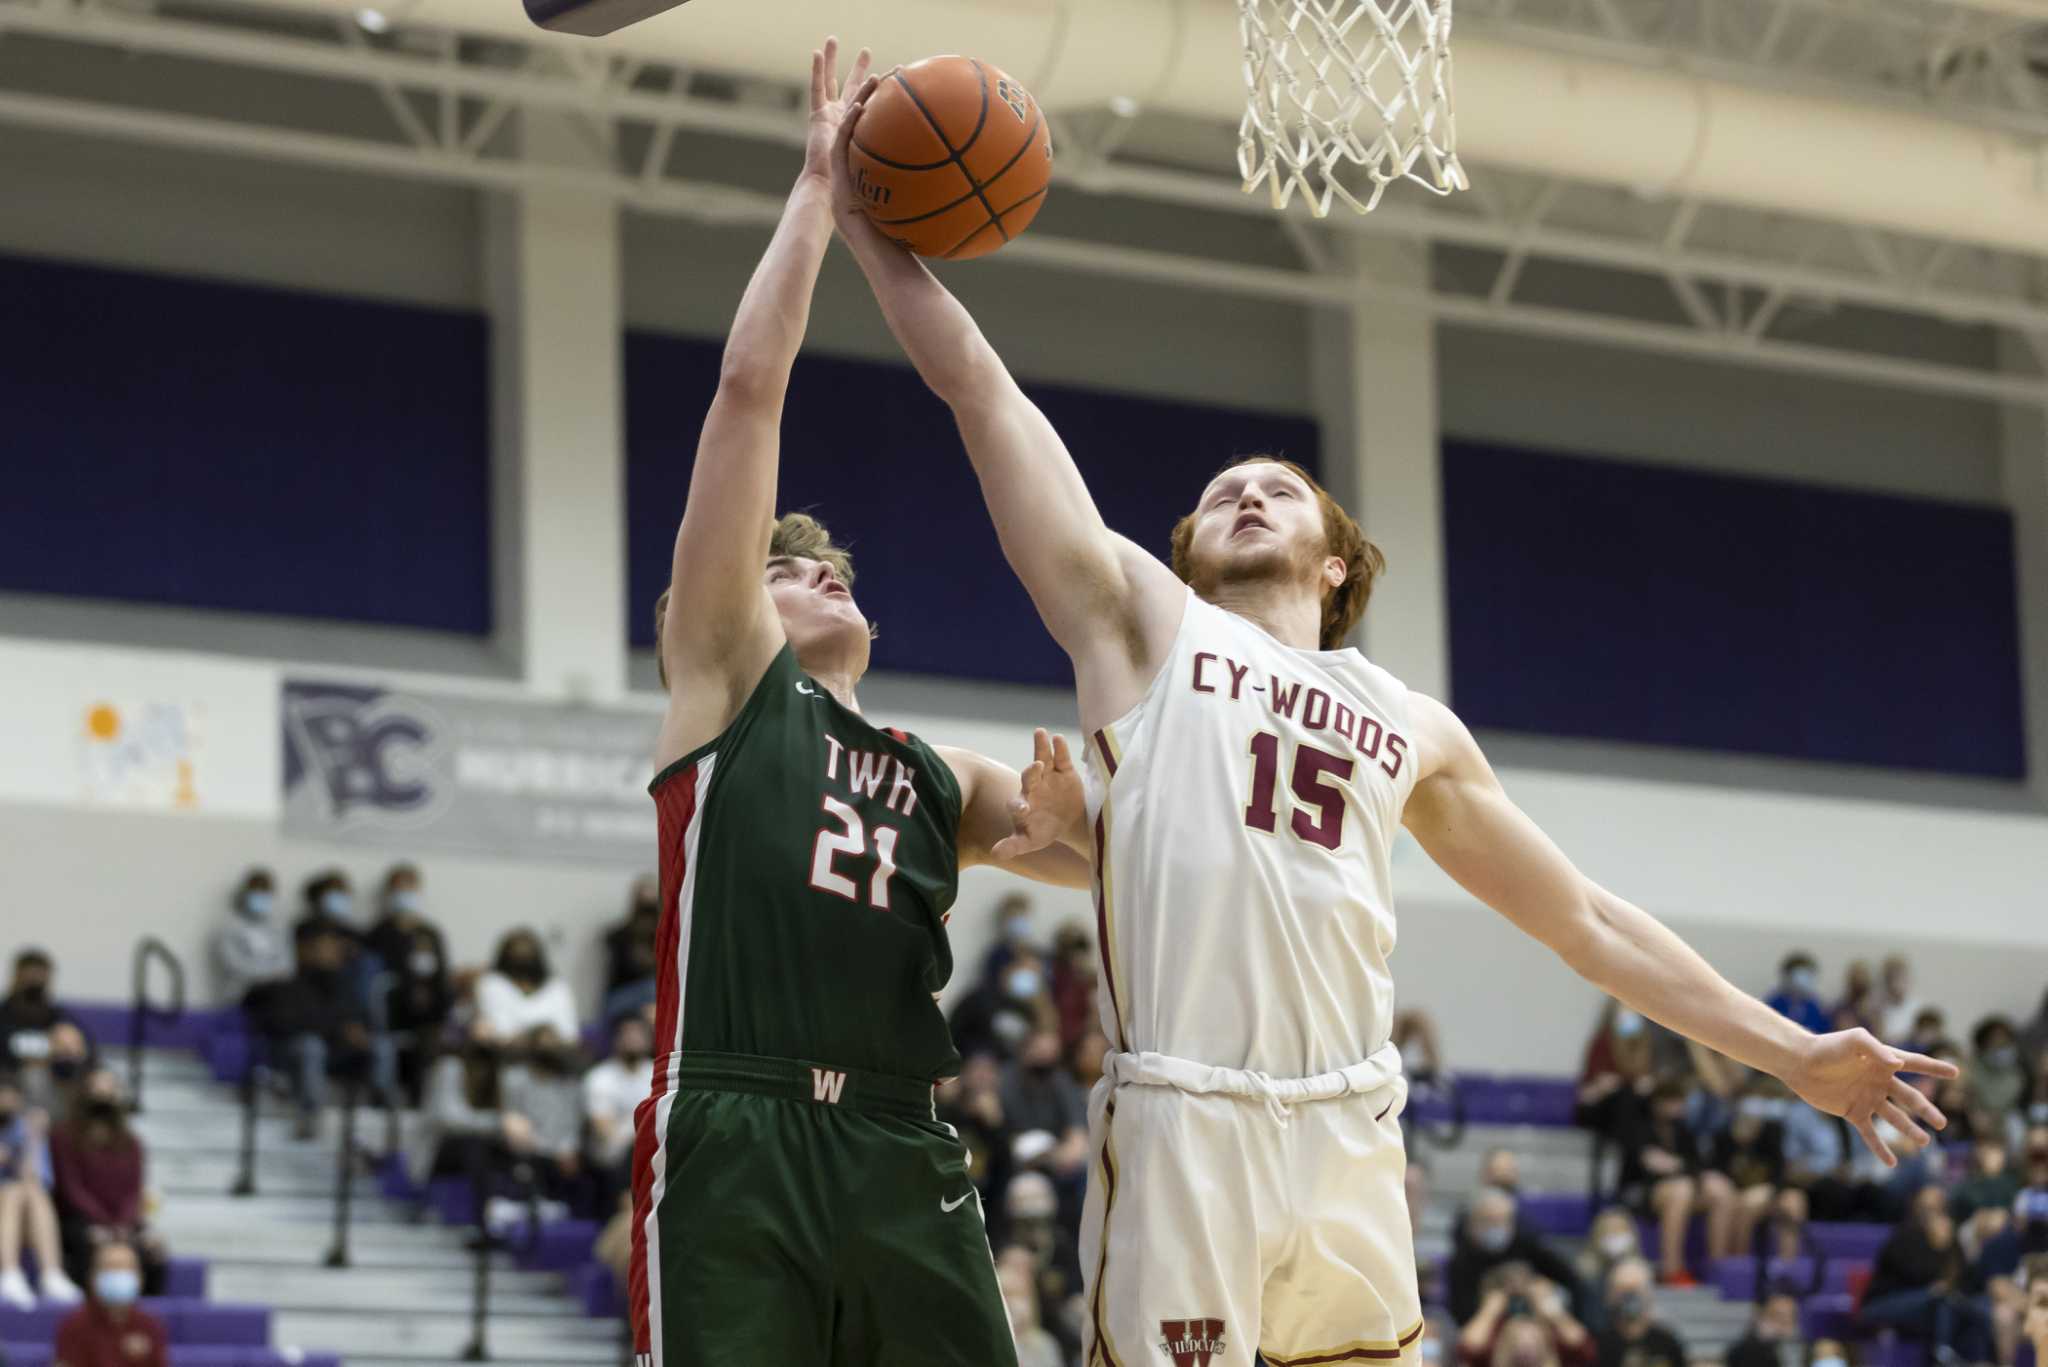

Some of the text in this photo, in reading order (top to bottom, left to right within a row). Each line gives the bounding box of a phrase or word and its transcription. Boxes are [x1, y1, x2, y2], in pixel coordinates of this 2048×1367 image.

[823, 732, 917, 817] TWH
[1191, 650, 1409, 780] CY-WOODS
[1243, 729, 1356, 852] 15
[809, 792, 899, 911] 21
[810, 1067, 847, 1105] W
